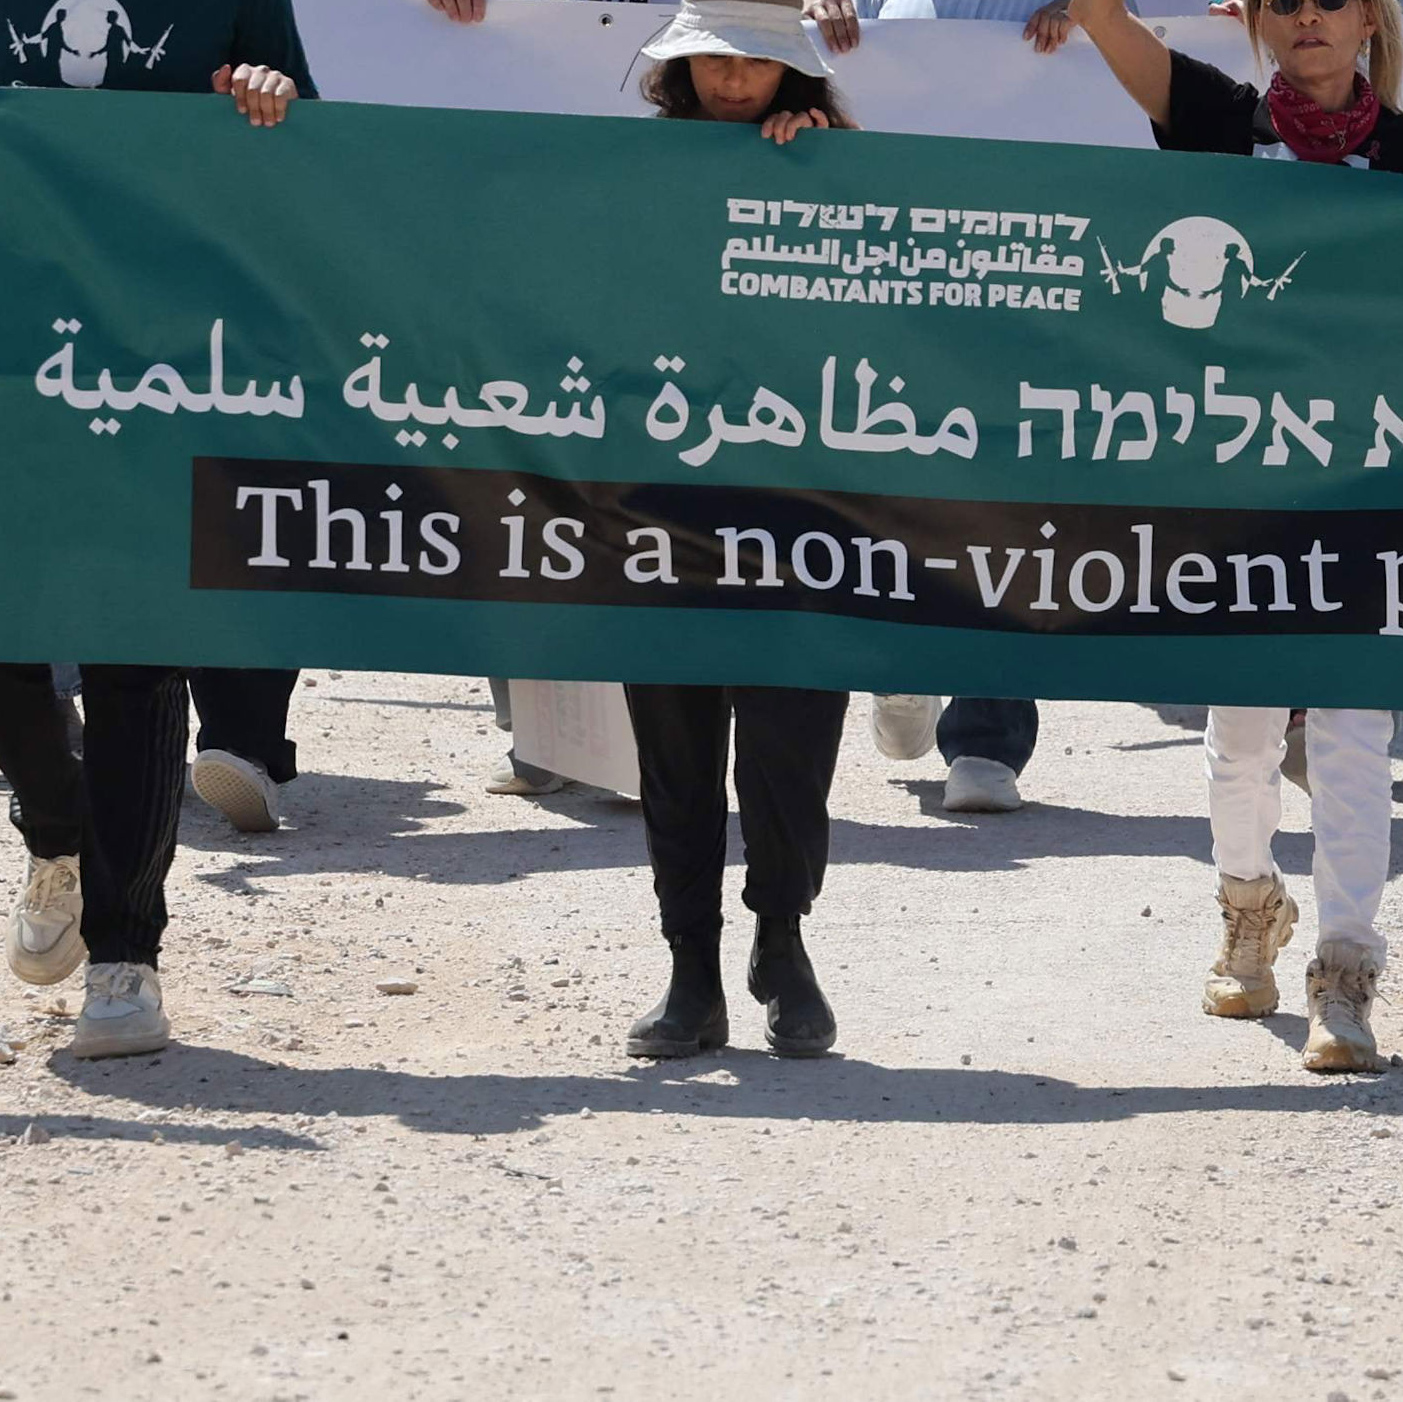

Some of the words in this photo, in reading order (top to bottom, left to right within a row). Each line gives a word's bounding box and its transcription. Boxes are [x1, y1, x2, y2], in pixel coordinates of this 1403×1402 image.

[727, 198, 899, 231] לשלום
[909, 207, 1091, 240] לוחמים
[721, 234, 840, 270] السلام
[899, 237, 947, 276] من
[949, 238, 1083, 279] مقاتلون
[721, 270, 923, 305] COMBATANTS
[929, 281, 982, 307] FOR
[988, 283, 1082, 311] PEACE
[33, 318, 306, 435] سلمية
[342, 332, 605, 451] شعبية
[645, 354, 978, 466] مظاهرة
[1016, 365, 1336, 469] אלימה
[235, 479, 462, 576] This
[499, 488, 587, 582] is
[622, 525, 680, 585] a
[714, 522, 1342, 615] non-violent
